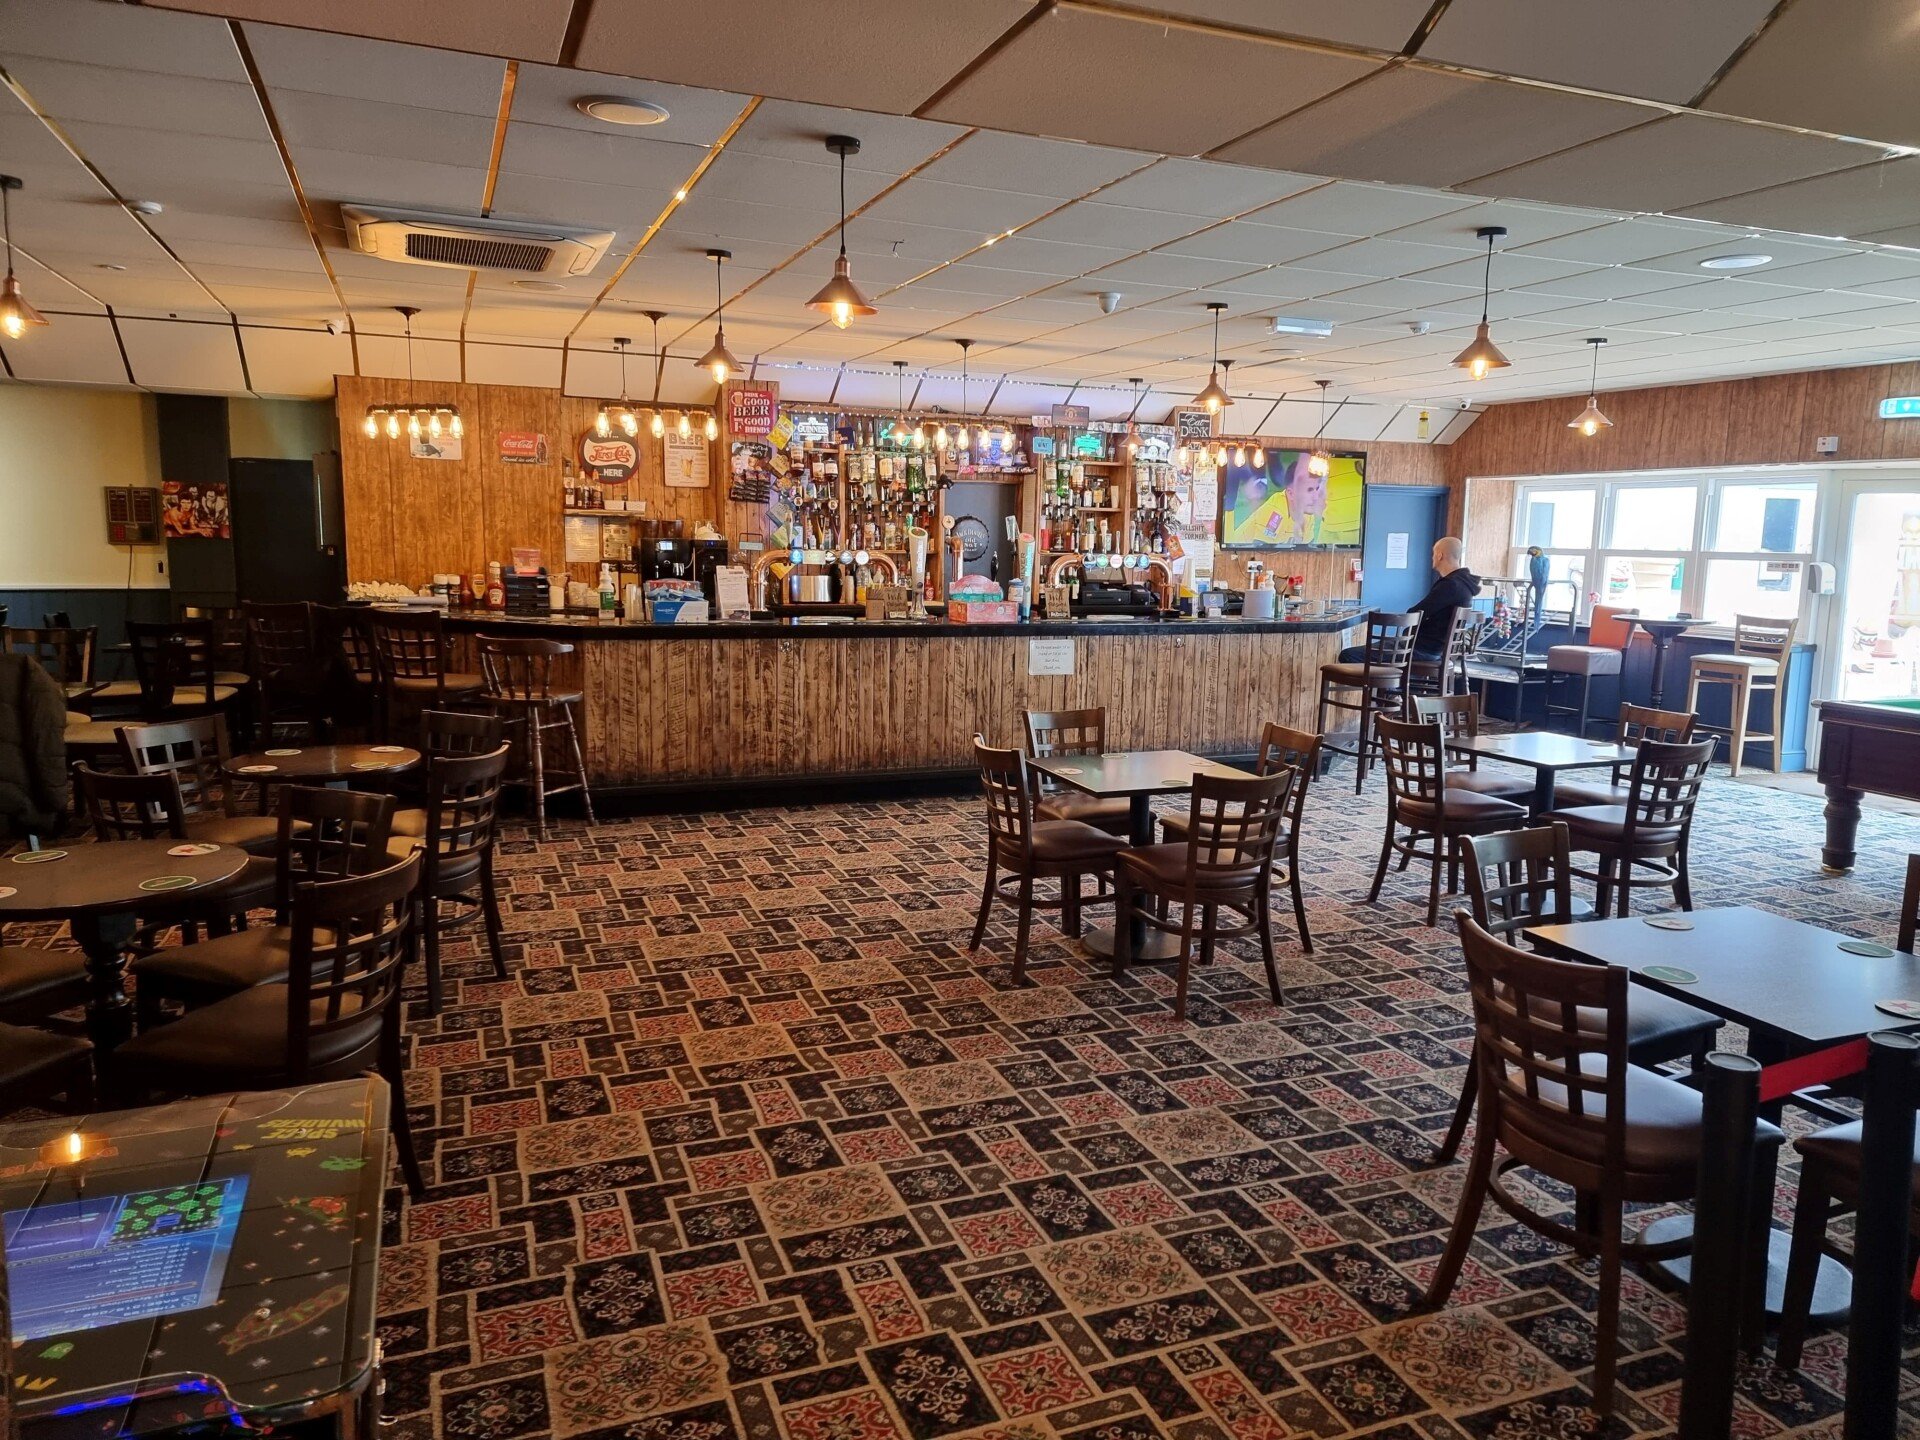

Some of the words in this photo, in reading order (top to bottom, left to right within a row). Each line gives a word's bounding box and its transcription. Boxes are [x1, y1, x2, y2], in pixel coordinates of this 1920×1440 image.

[743, 397, 770, 406] GOOD
[733, 406, 770, 416] BEER
[744, 417, 770, 426] GOOD
[1184, 414, 1205, 426] Eat
[798, 425, 829, 433] GUINNESS
[1180, 426, 1208, 438] DRINK
[256, 1118, 366, 1128] INVADERS
